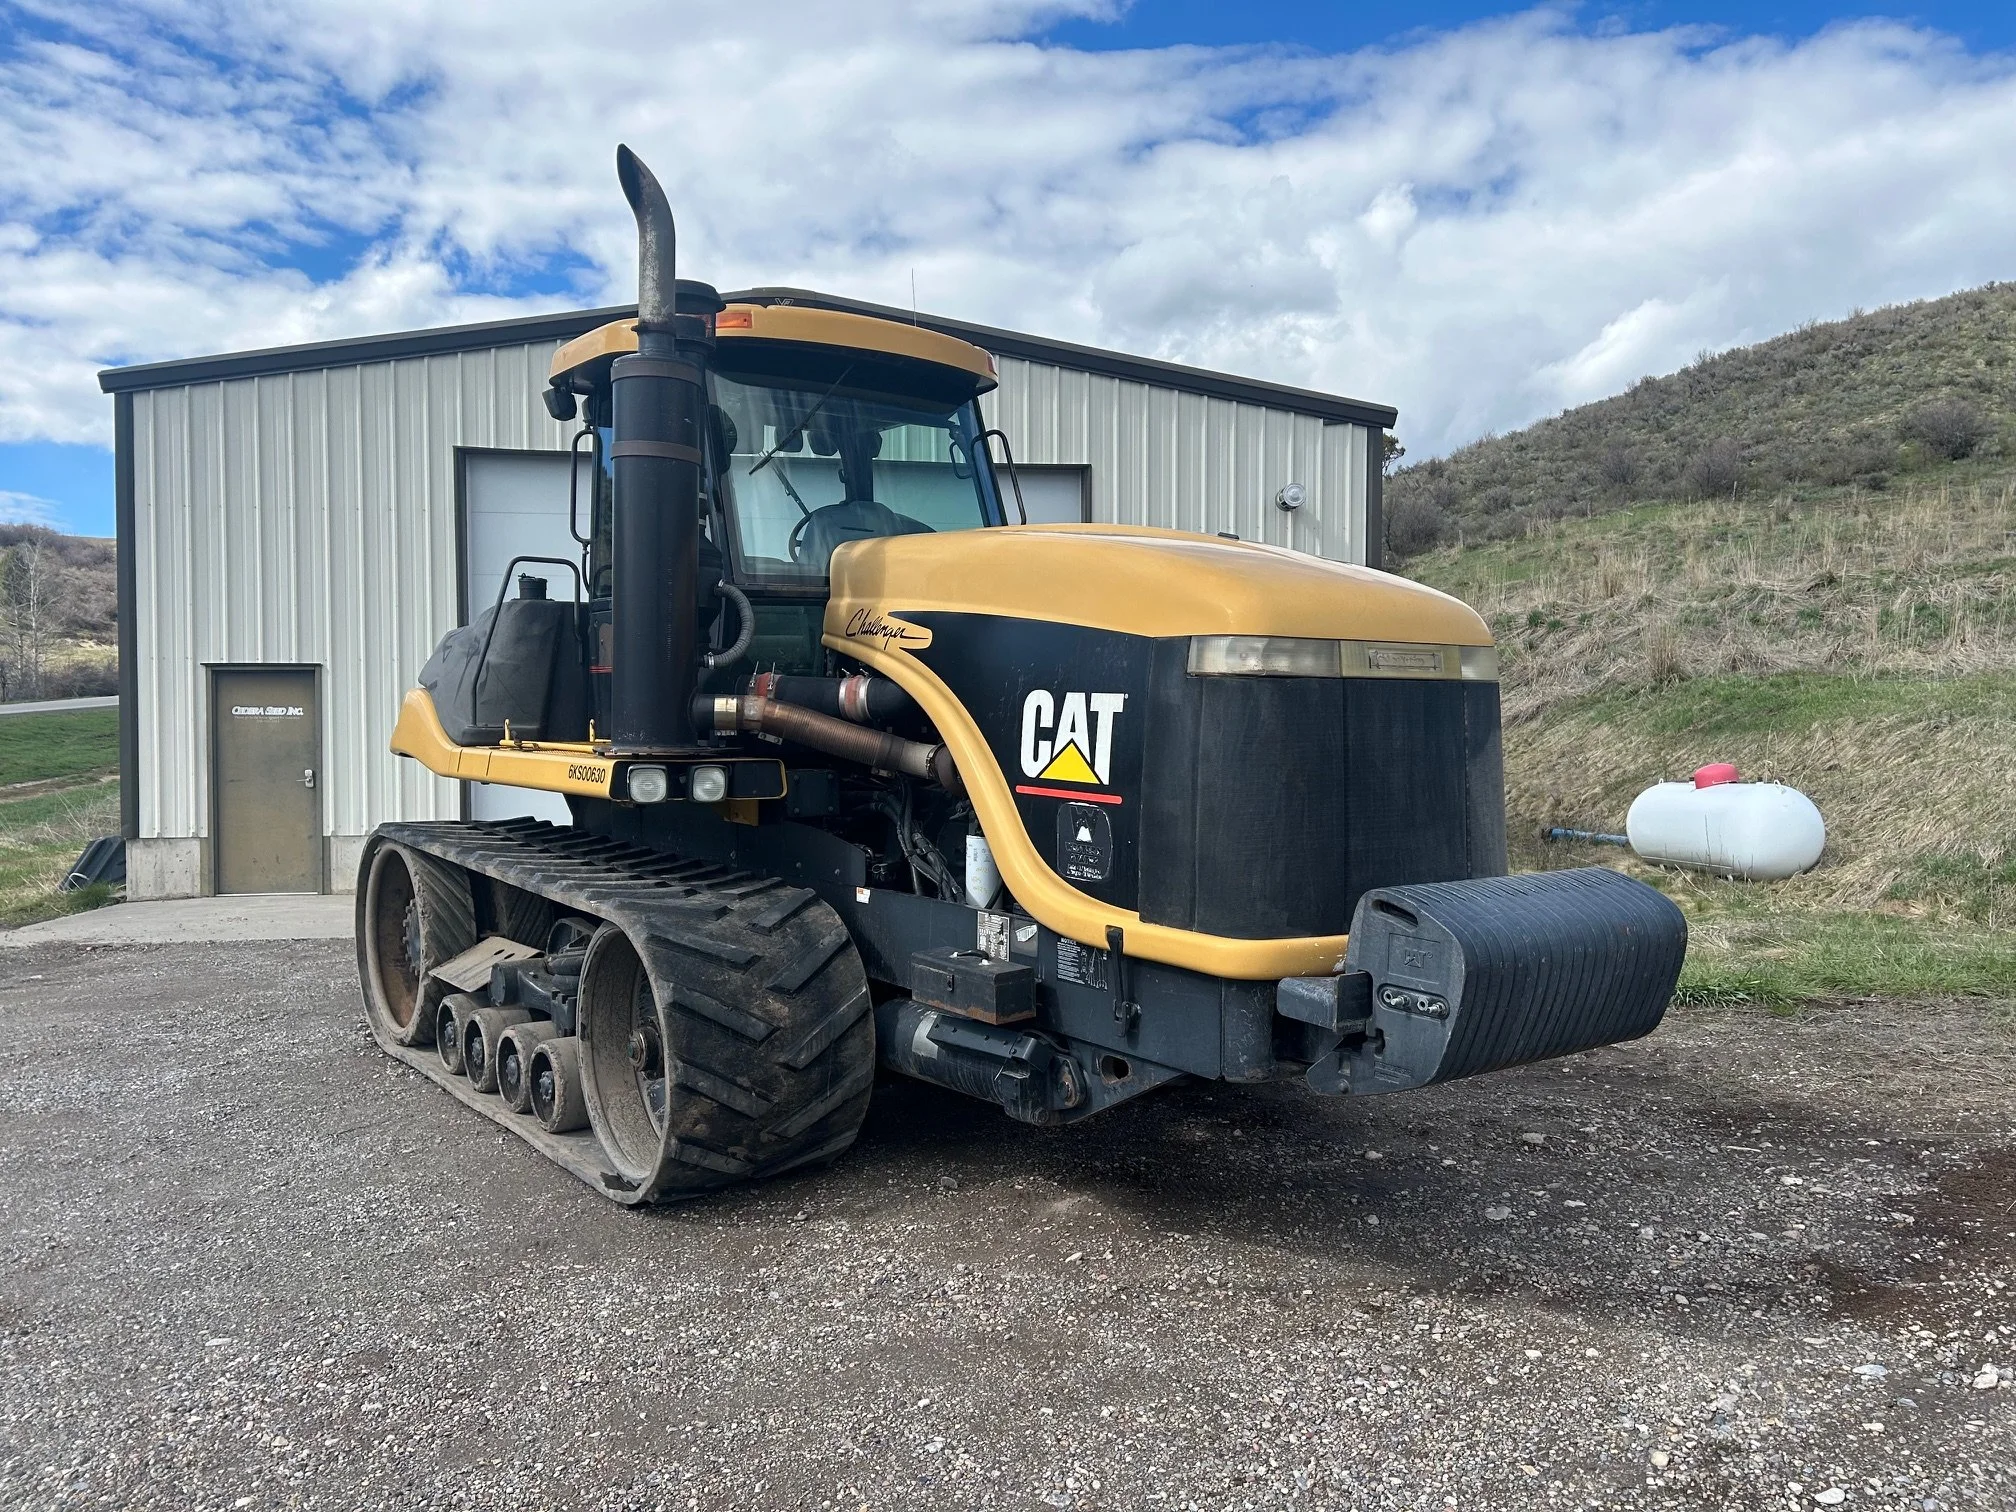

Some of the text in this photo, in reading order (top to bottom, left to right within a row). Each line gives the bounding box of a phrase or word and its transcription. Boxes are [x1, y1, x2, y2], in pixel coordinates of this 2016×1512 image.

[845, 608, 929, 651] Challenger
[1020, 689, 1125, 785] CAT
[568, 764, 606, 784] 6KS00630
